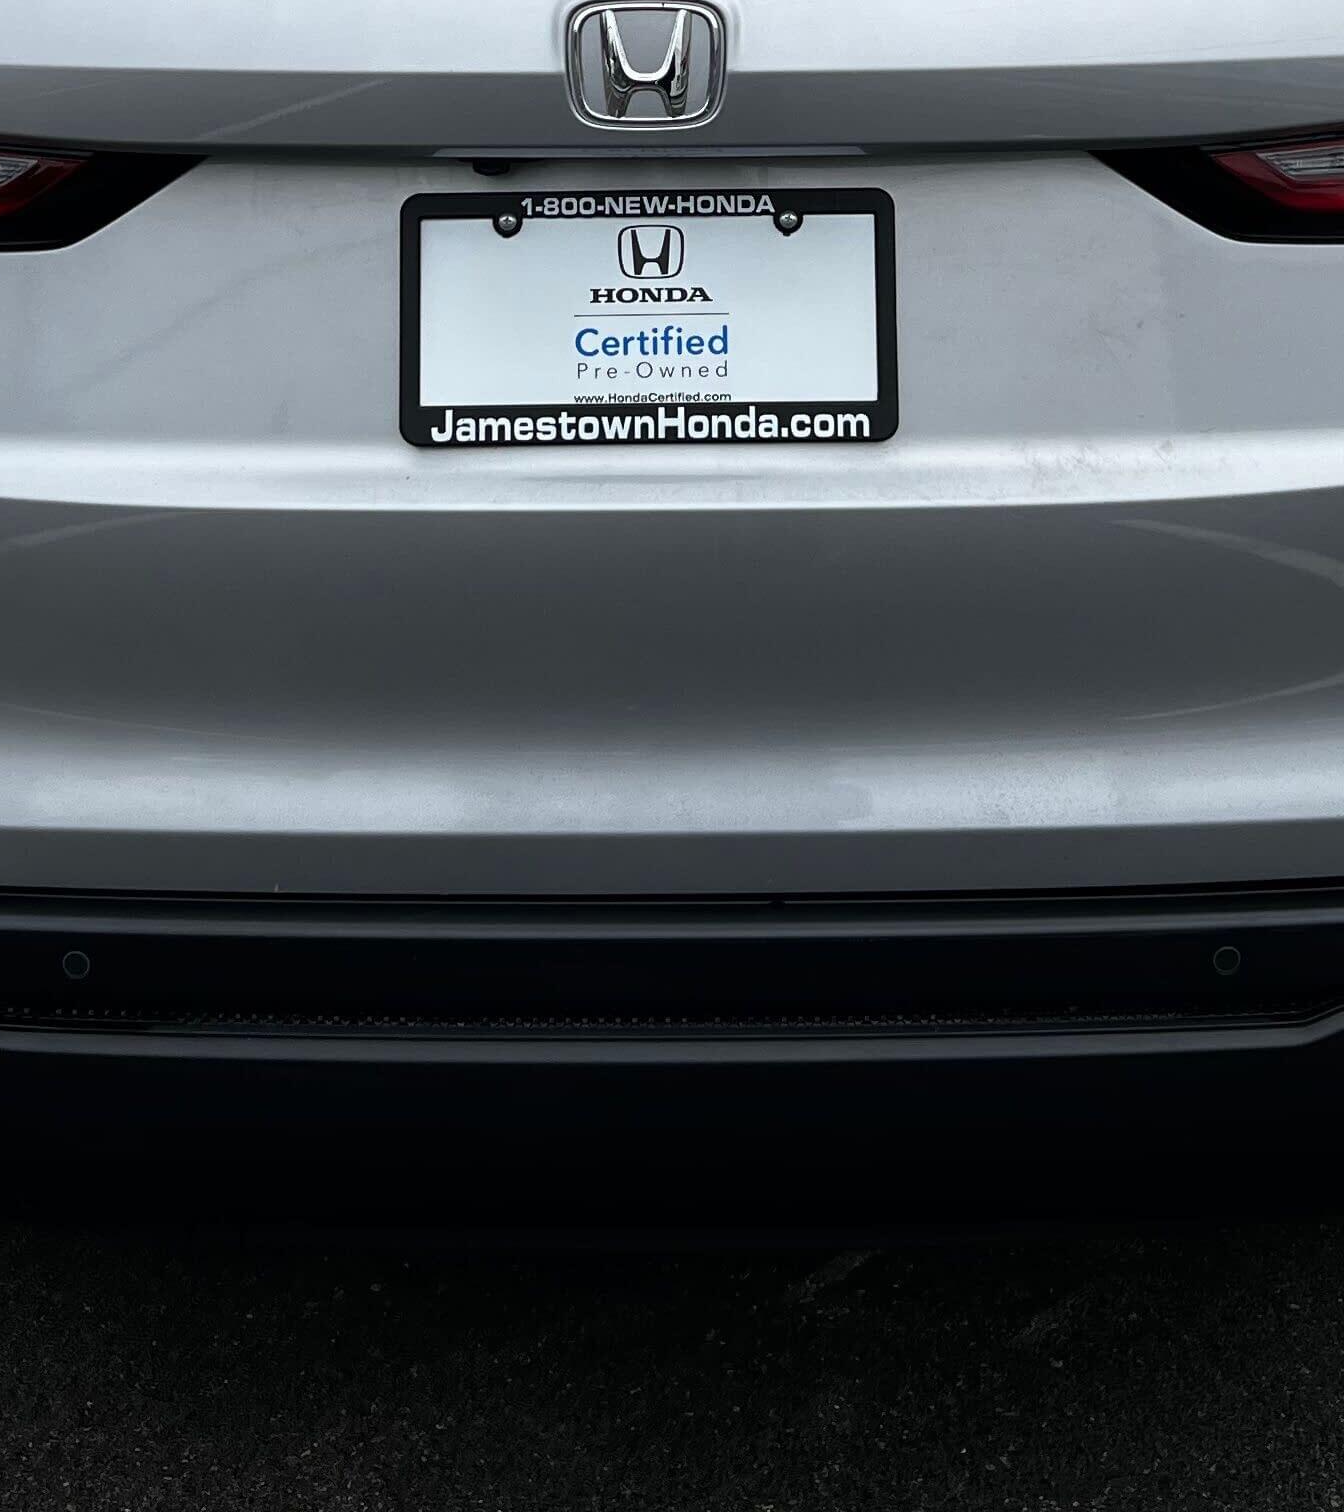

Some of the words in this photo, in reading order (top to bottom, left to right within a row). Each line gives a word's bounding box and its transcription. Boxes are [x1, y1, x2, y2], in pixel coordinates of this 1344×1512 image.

[520, 195, 776, 217] 1-800-NEW-HONDA
[589, 286, 714, 304] HONDA
[574, 324, 730, 358] Certified
[576, 360, 729, 380] Pre-Owned
[573, 391, 733, 404] www.HondaCertified.com
[430, 406, 872, 444] JamestownHonda.com
